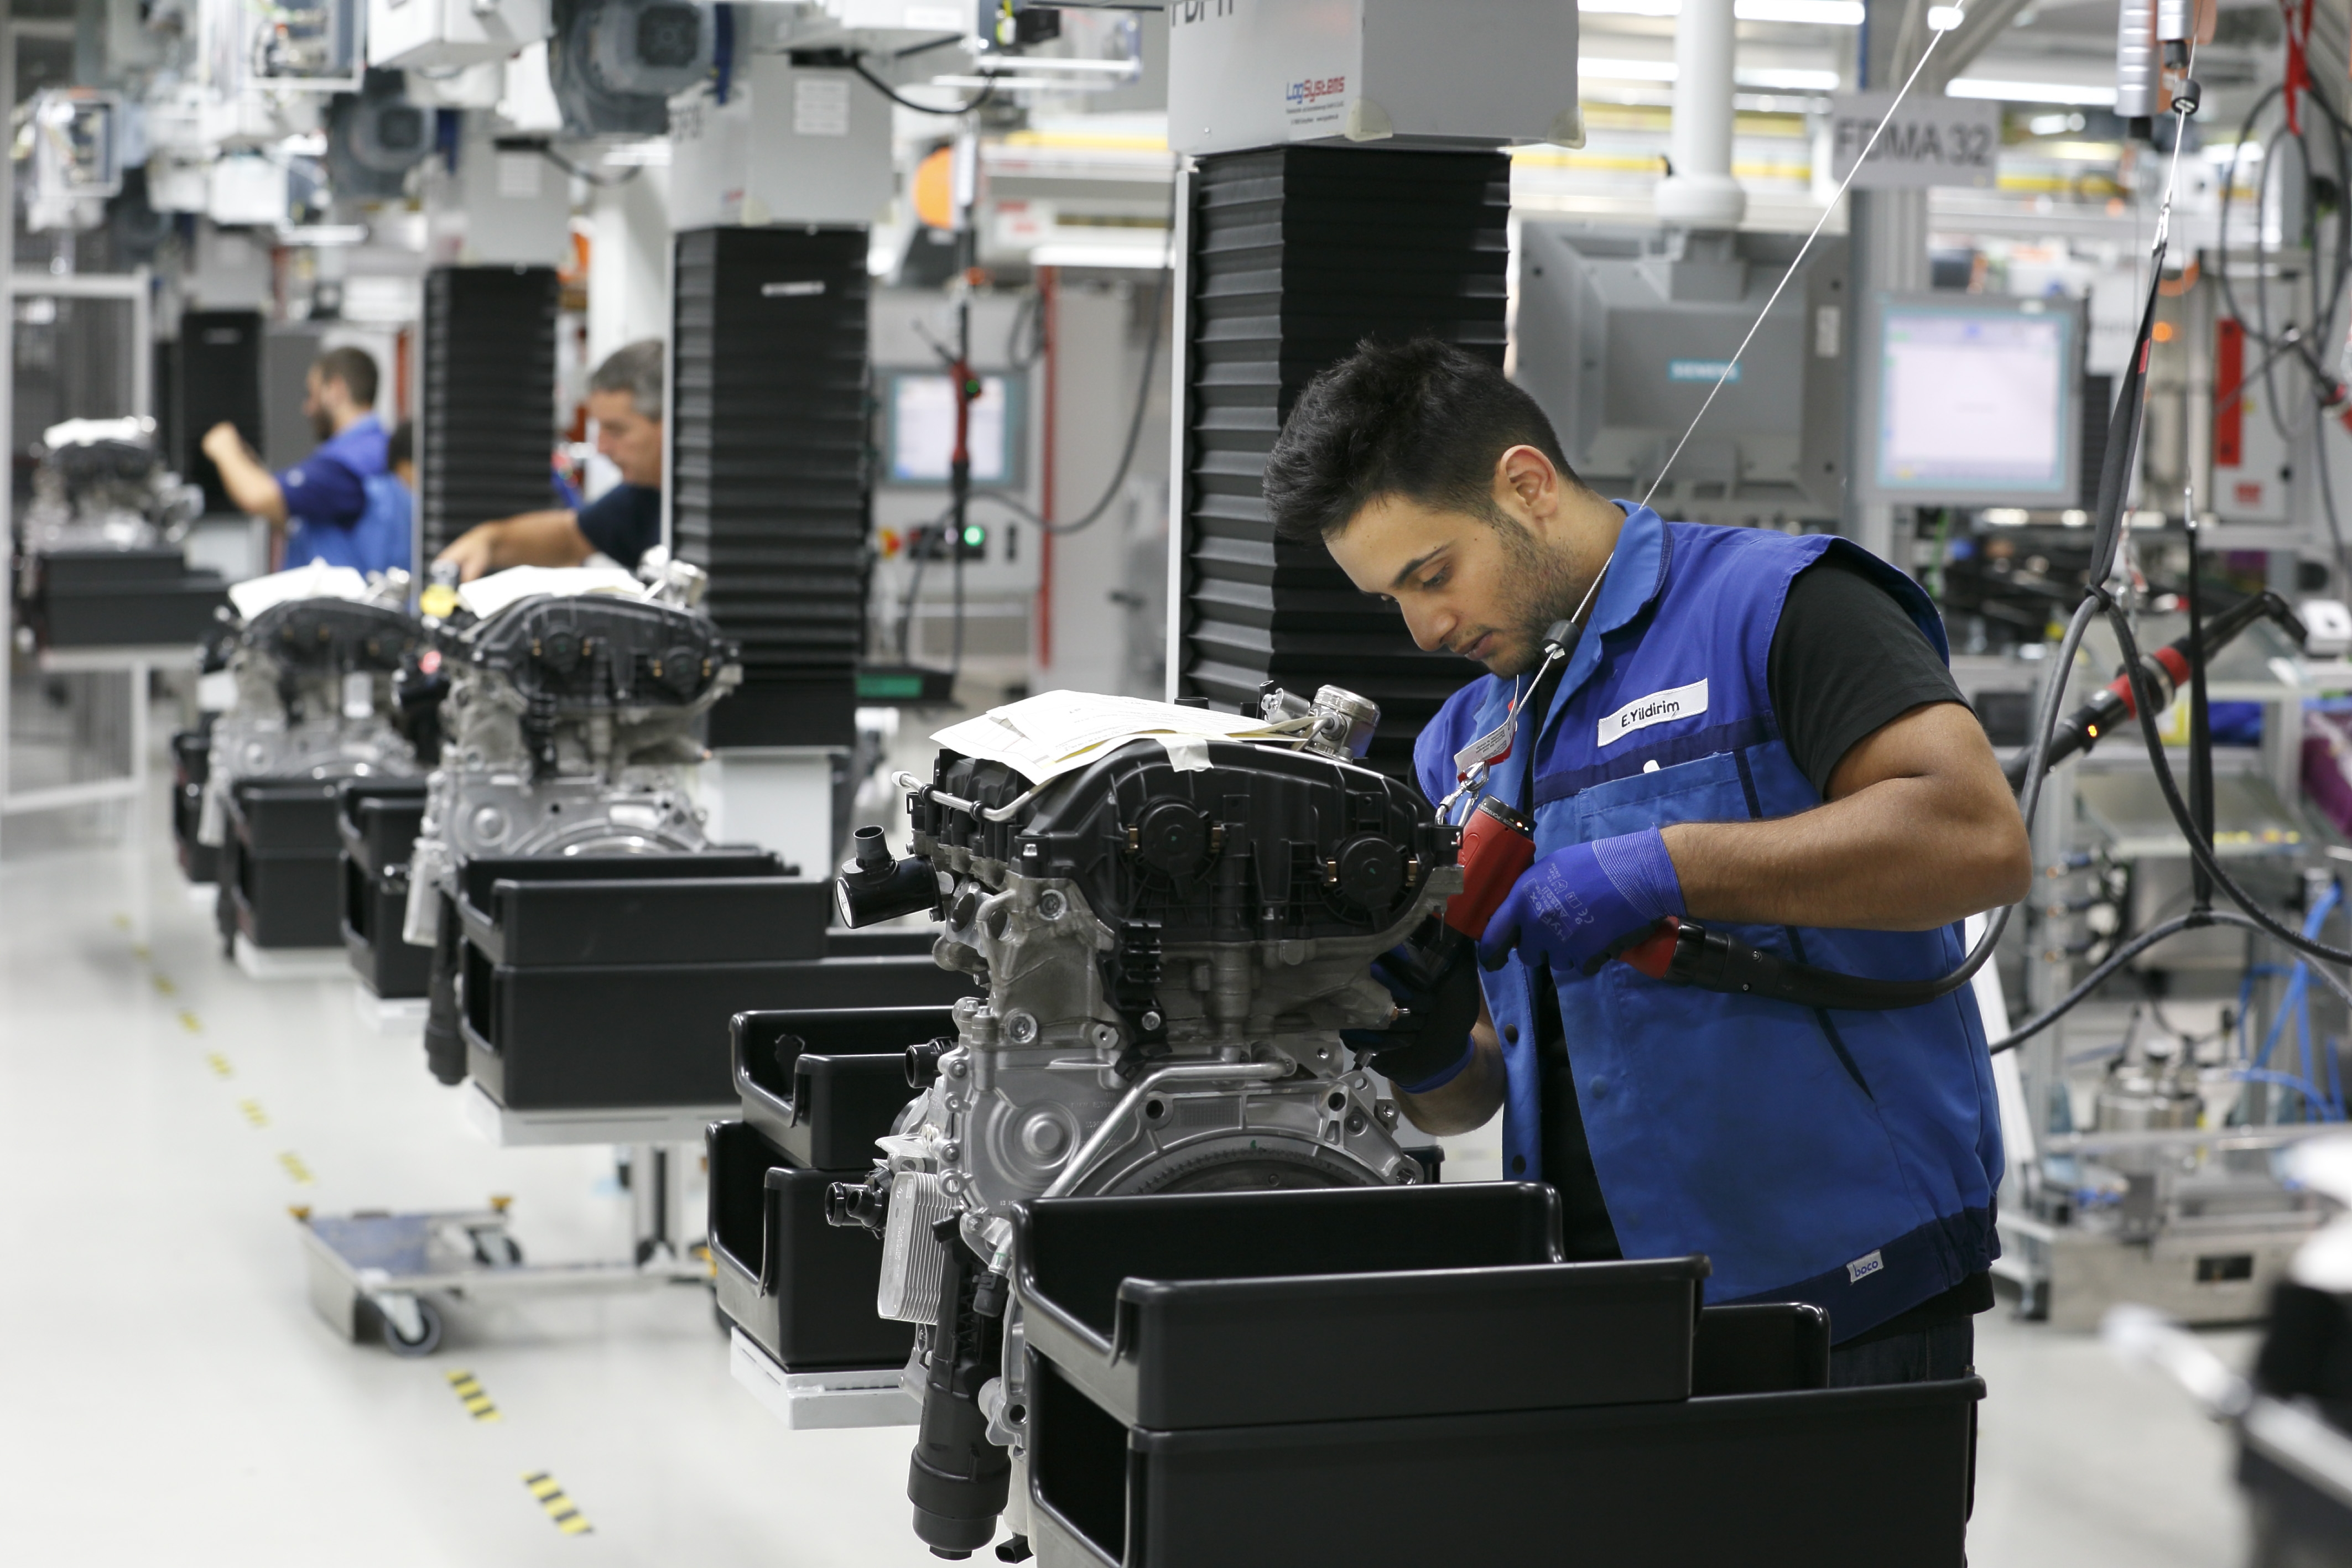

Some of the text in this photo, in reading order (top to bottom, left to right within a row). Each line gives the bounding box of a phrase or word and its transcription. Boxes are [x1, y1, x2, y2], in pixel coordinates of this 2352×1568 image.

[1286, 76, 1345, 104] LogSystems
[1835, 118, 1992, 166] FDMA 32
[1621, 700, 1680, 727] E.Yildirim
[1541, 887, 1567, 917] Ansell
[1530, 892, 1567, 942] HyFlex
[1853, 1261, 1879, 1277] boco
